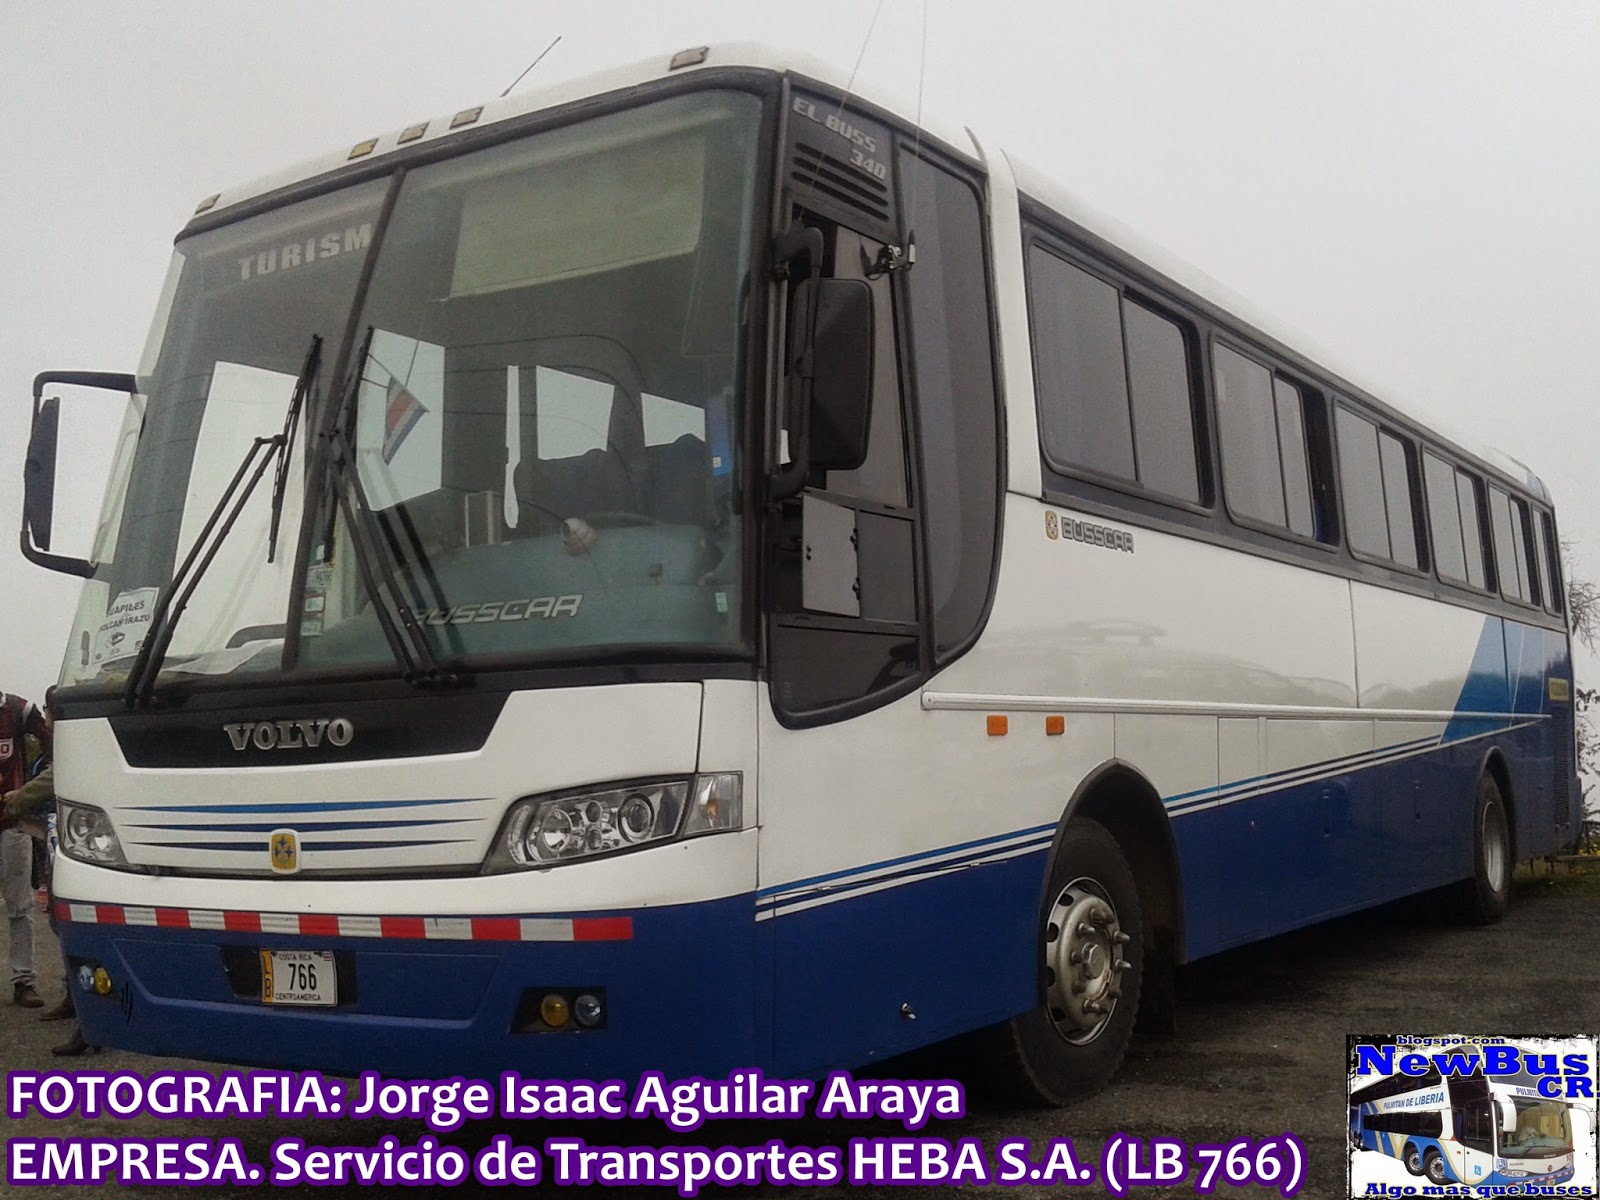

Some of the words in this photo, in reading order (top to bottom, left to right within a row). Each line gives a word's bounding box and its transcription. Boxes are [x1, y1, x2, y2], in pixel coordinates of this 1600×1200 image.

[792, 97, 821, 124] EL
[824, 114, 877, 153] BUSS
[850, 148, 886, 181] 340
[1061, 516, 1134, 554] BUSSCAR
[222, 719, 354, 751] VOLVO
[279, 952, 297, 961] COSTA
[299, 952, 312, 961] RICA
[288, 963, 317, 991] 766
